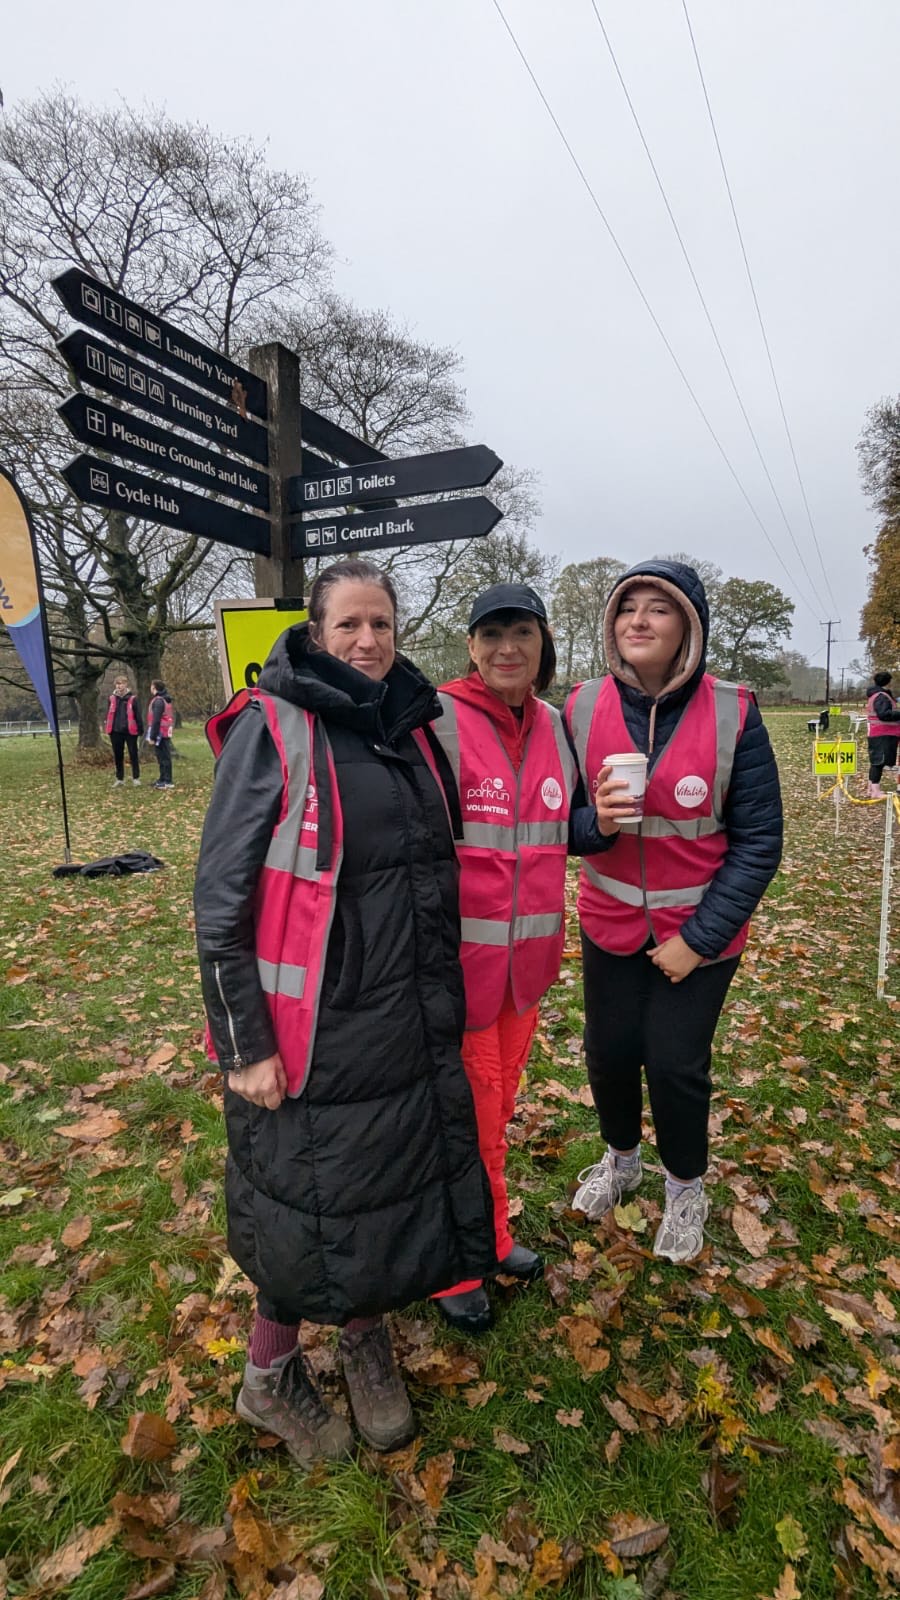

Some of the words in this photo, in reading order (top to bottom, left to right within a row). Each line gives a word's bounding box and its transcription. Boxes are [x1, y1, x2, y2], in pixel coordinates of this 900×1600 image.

[165, 337, 213, 377] Laundry
[110, 362, 125, 378] WC
[169, 392, 213, 429] Turning
[215, 415, 238, 438] Yard
[112, 422, 166, 457] Pleasure
[169, 447, 216, 478] Grounds
[218, 466, 238, 486] and
[239, 473, 258, 494] lake
[357, 474, 396, 490] Toilets
[115, 481, 150, 507] Cycle
[153, 493, 180, 515] Hub
[340, 522, 384, 541] Central
[386, 519, 415, 535] Bark
[467, 783, 510, 802] parkrun
[676, 784, 706, 798] Vitality
[466, 804, 509, 815] VOLUNTEER
